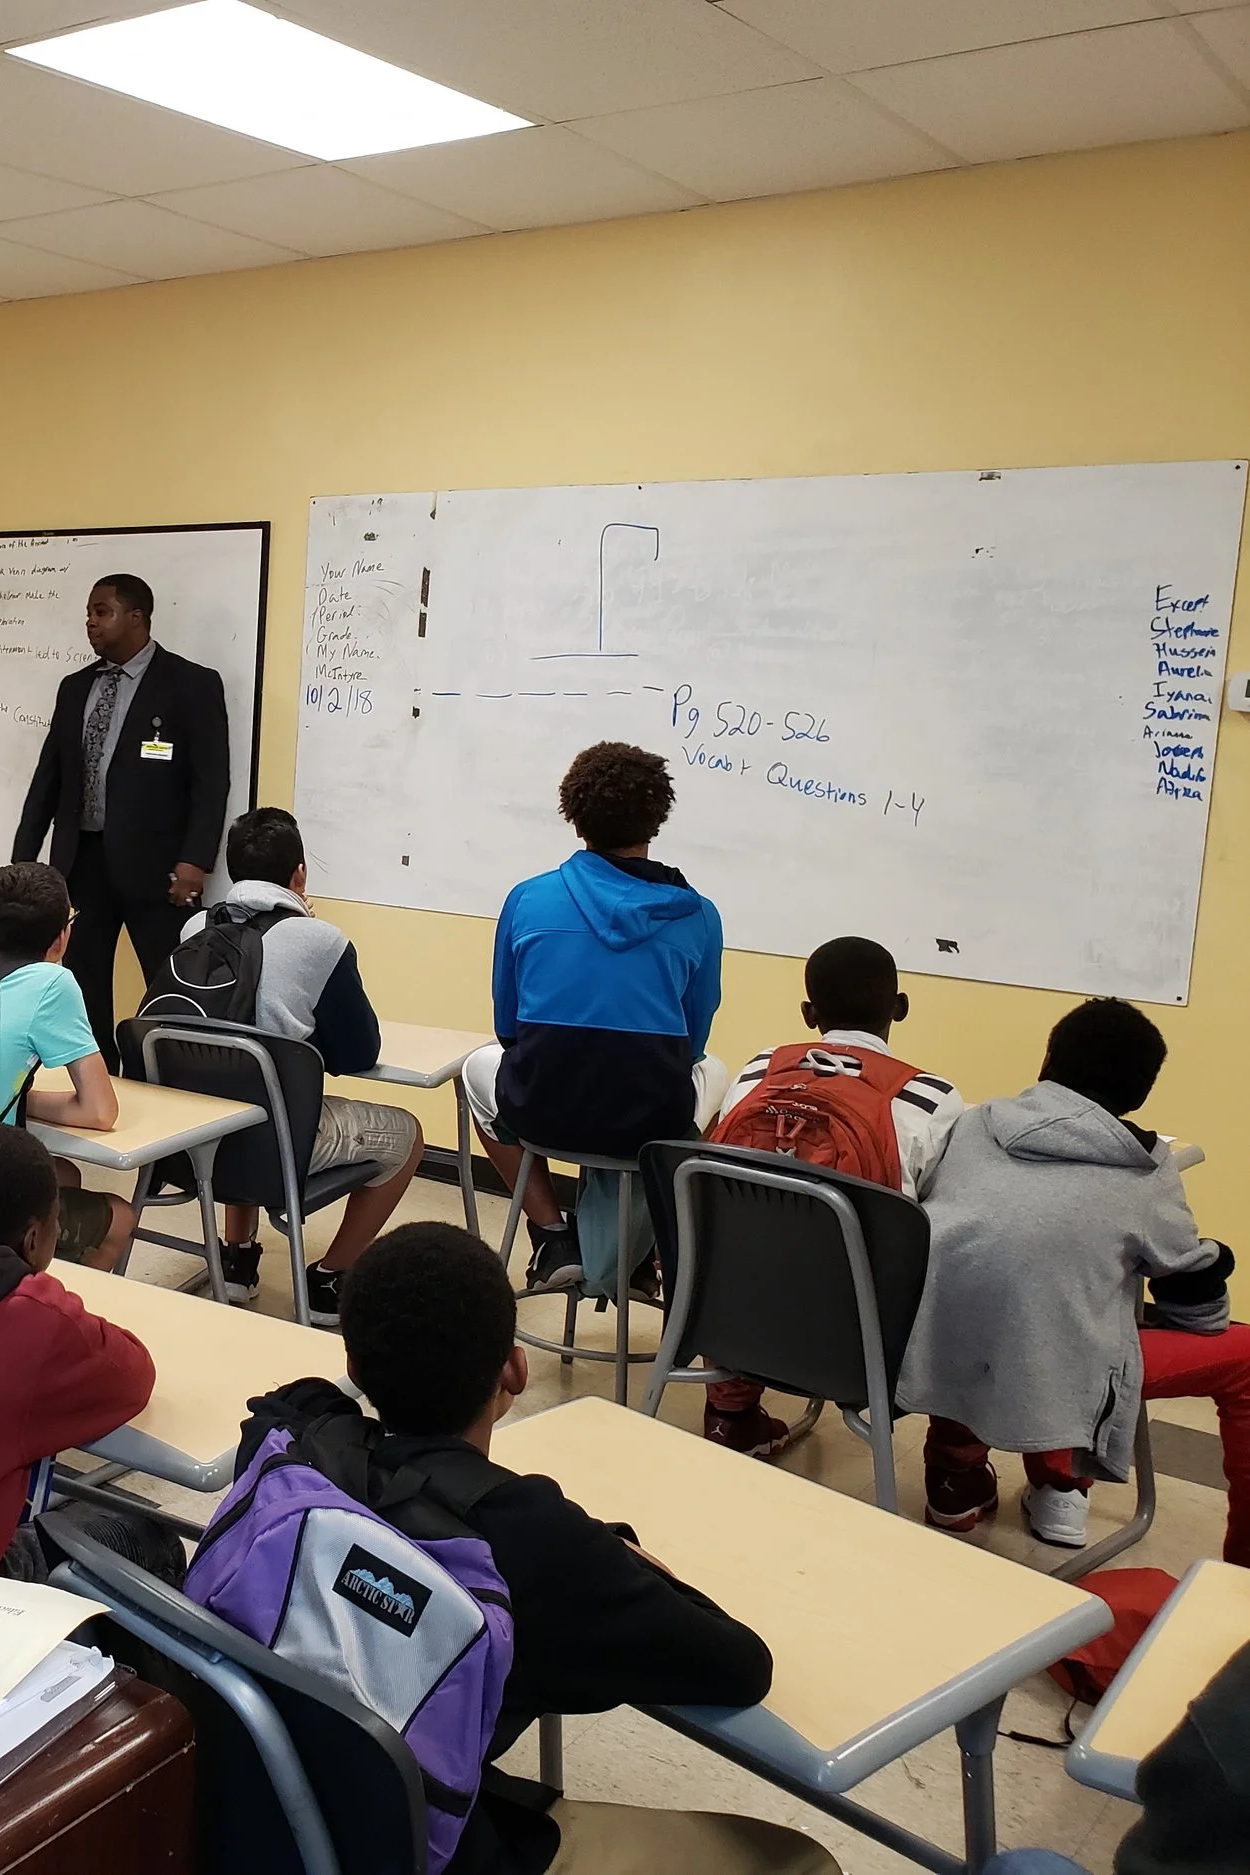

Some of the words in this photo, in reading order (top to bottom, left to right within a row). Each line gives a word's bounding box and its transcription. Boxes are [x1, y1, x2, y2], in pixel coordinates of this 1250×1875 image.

[320, 562, 346, 582] Your
[352, 558, 385, 578] Name
[65, 646, 98, 663] Scien
[317, 644, 337, 662] My
[315, 663, 368, 684] McIntyre
[306, 684, 373, 717] 10/2/18
[672, 684, 700, 739] Pg
[681, 743, 732, 772] Vocab
[766, 762, 867, 806] Questions
[884, 790, 925, 827] 1-4
[340, 1570, 383, 1604] ARCTIC
